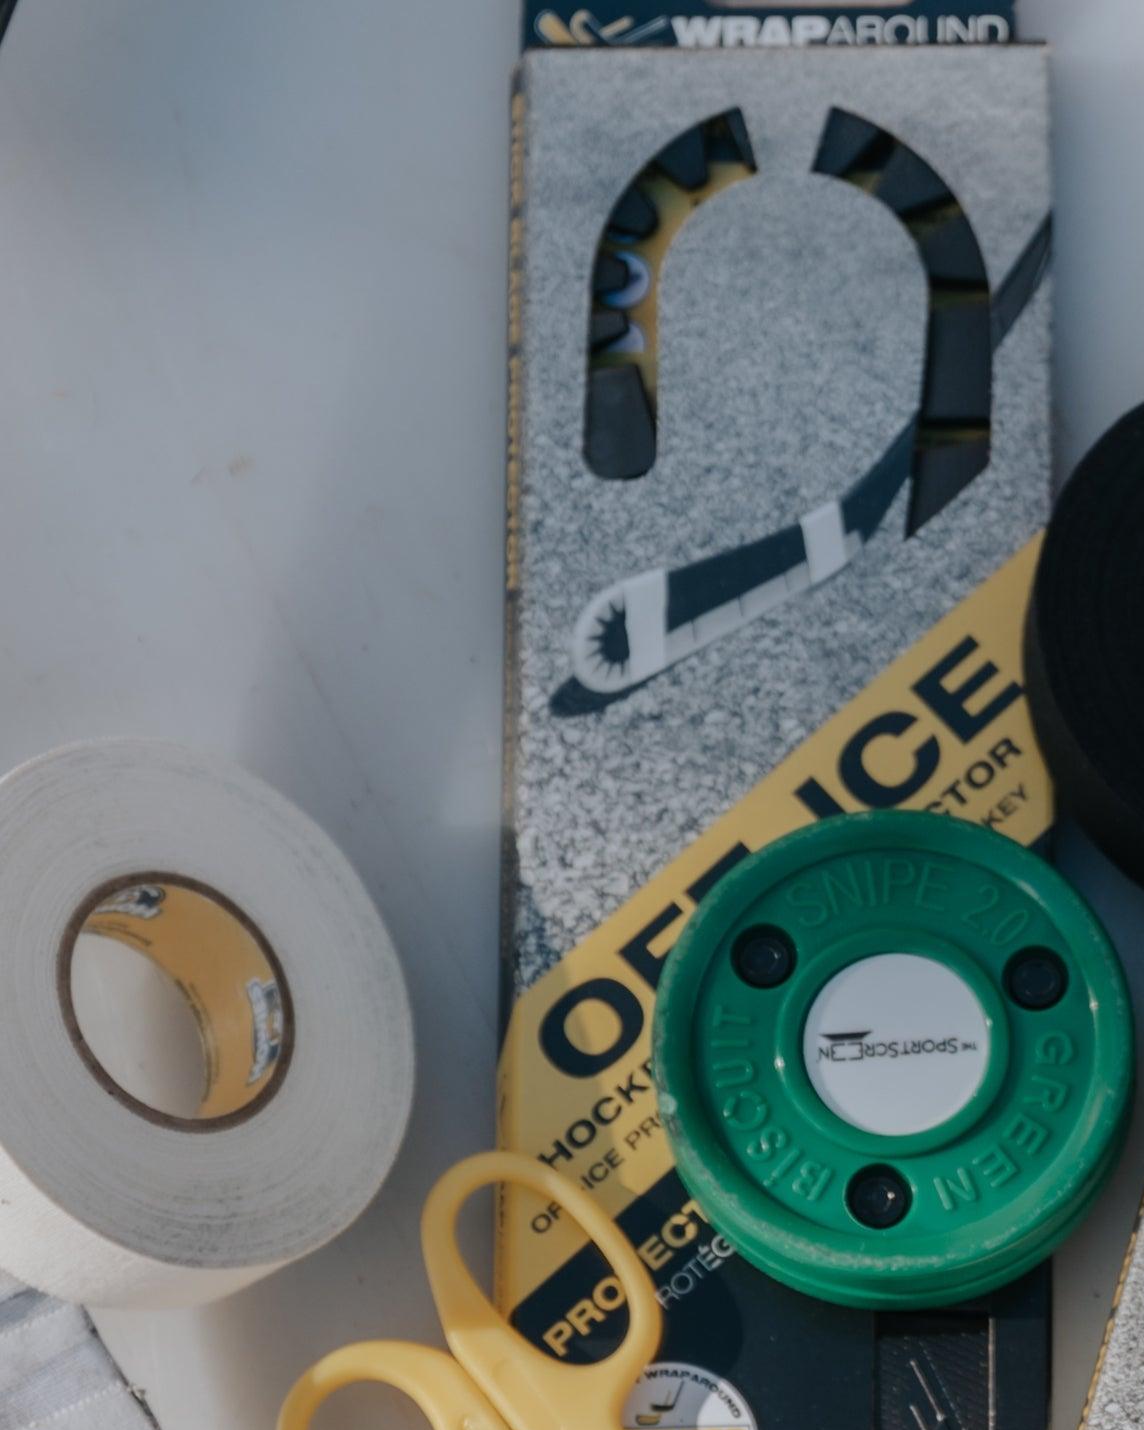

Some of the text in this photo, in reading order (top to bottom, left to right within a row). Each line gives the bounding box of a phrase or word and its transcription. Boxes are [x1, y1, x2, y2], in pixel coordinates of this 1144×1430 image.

[671, 14, 1011, 46] WRAPAROUND
[539, 635, 1024, 1079] OFICE
[788, 861, 1031, 945] SNIPE 2.0
[538, 1057, 654, 1170] HOCK
[936, 1030, 1071, 1211] GREEN
[543, 1199, 709, 1357] PROECT
[655, 1233, 736, 1310] ROTÉG
[644, 1369, 741, 1419] WRAPAROUND
